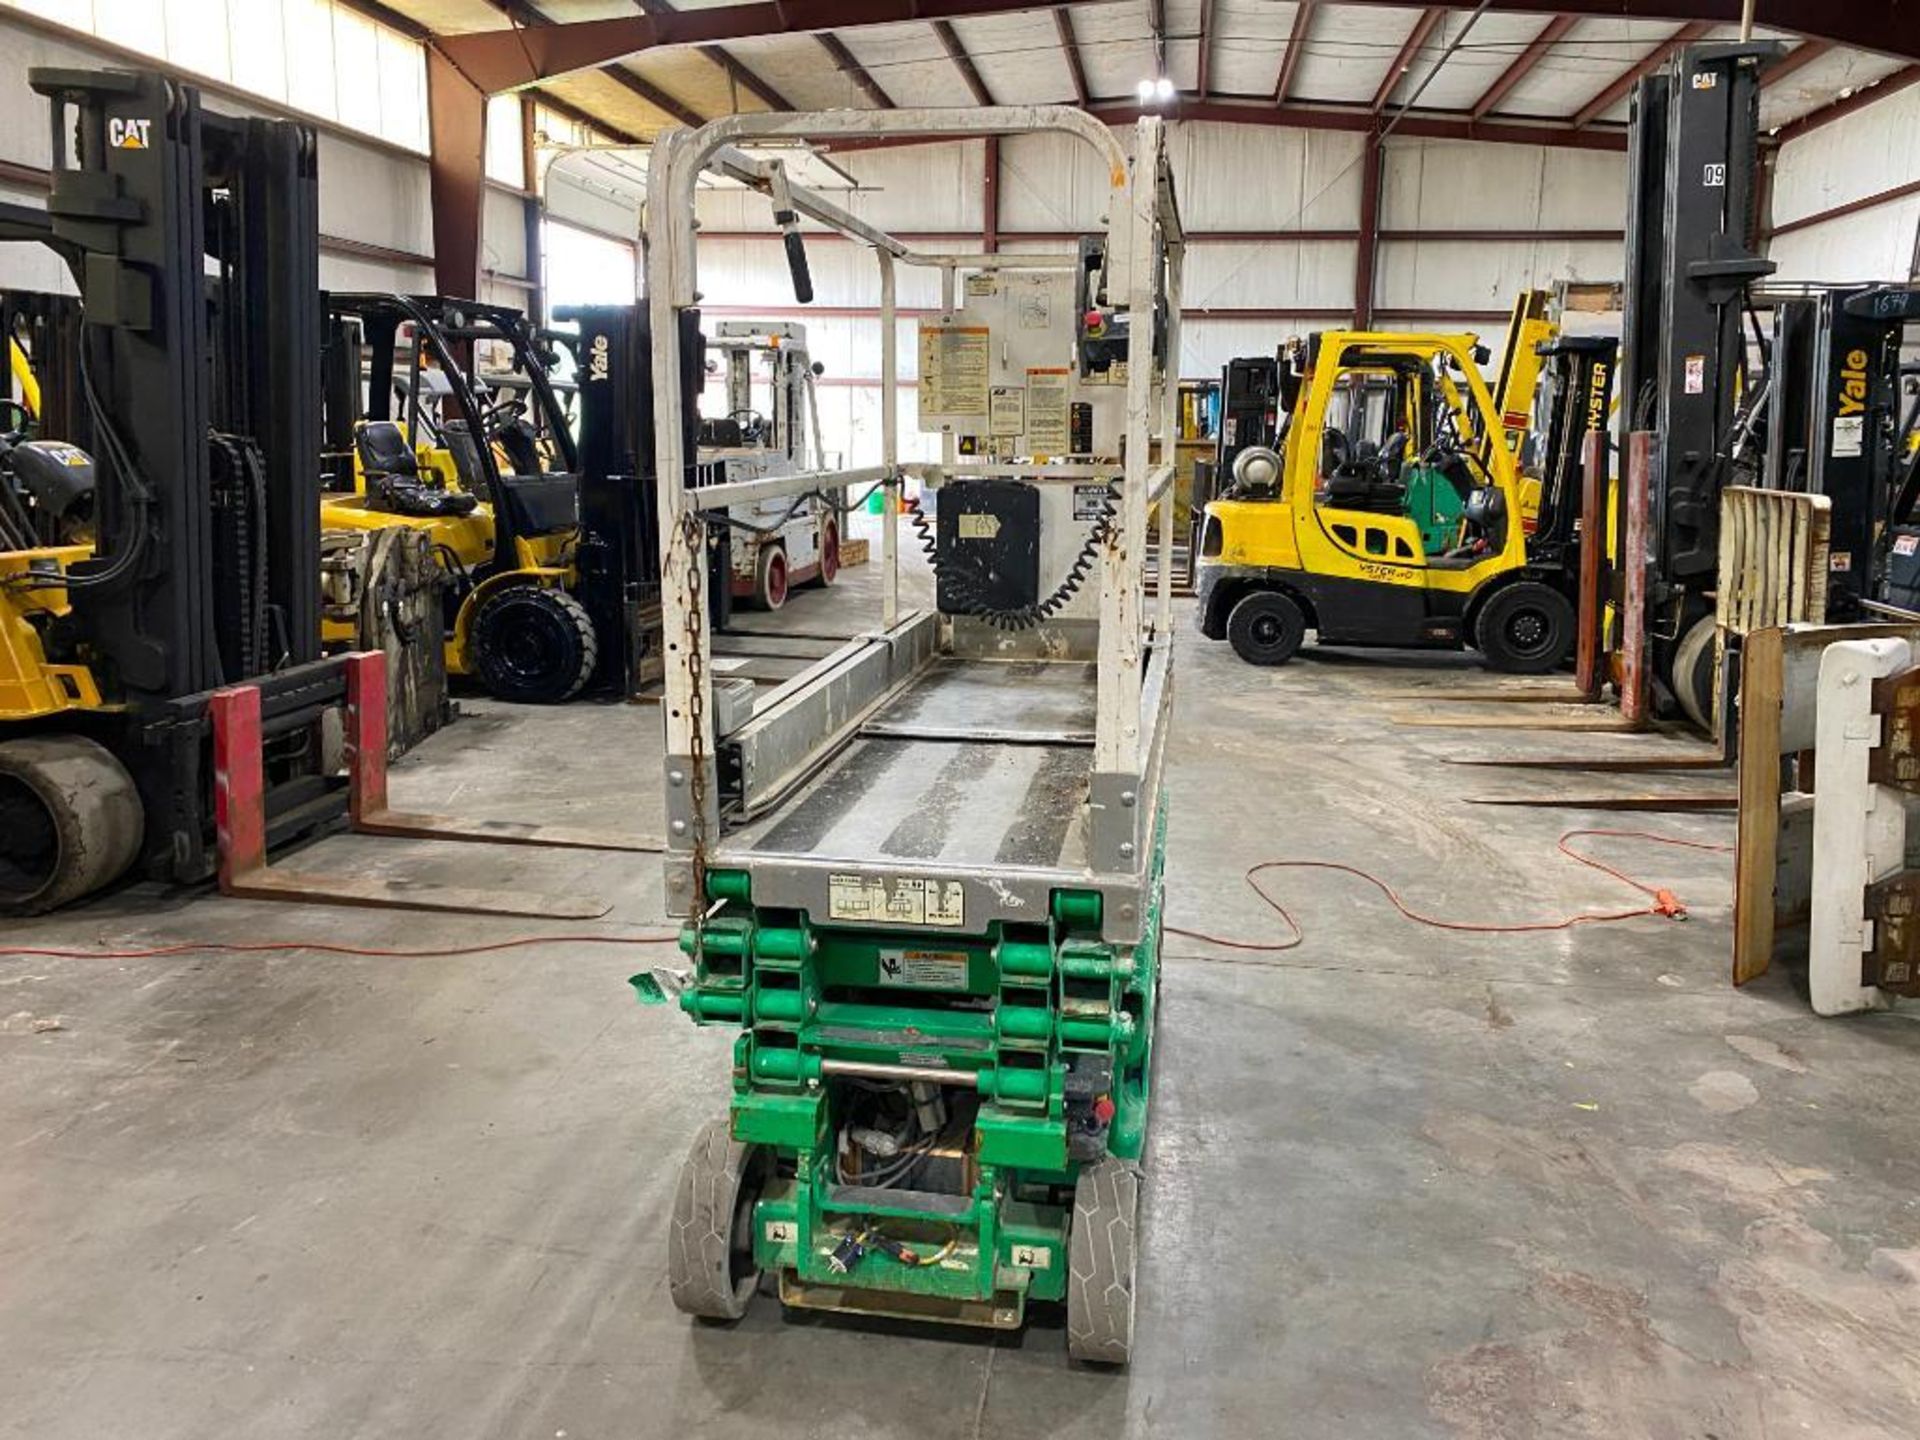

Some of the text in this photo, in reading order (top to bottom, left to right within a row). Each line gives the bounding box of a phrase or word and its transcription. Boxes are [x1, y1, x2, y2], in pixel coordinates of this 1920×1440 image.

[1692, 72, 1718, 89] CAT
[109, 117, 151, 149] CAT
[1706, 166, 1724, 184] 09
[590, 334, 608, 381] Yale
[1586, 362, 1607, 432] HYSTER
[1839, 349, 1868, 416] Yale
